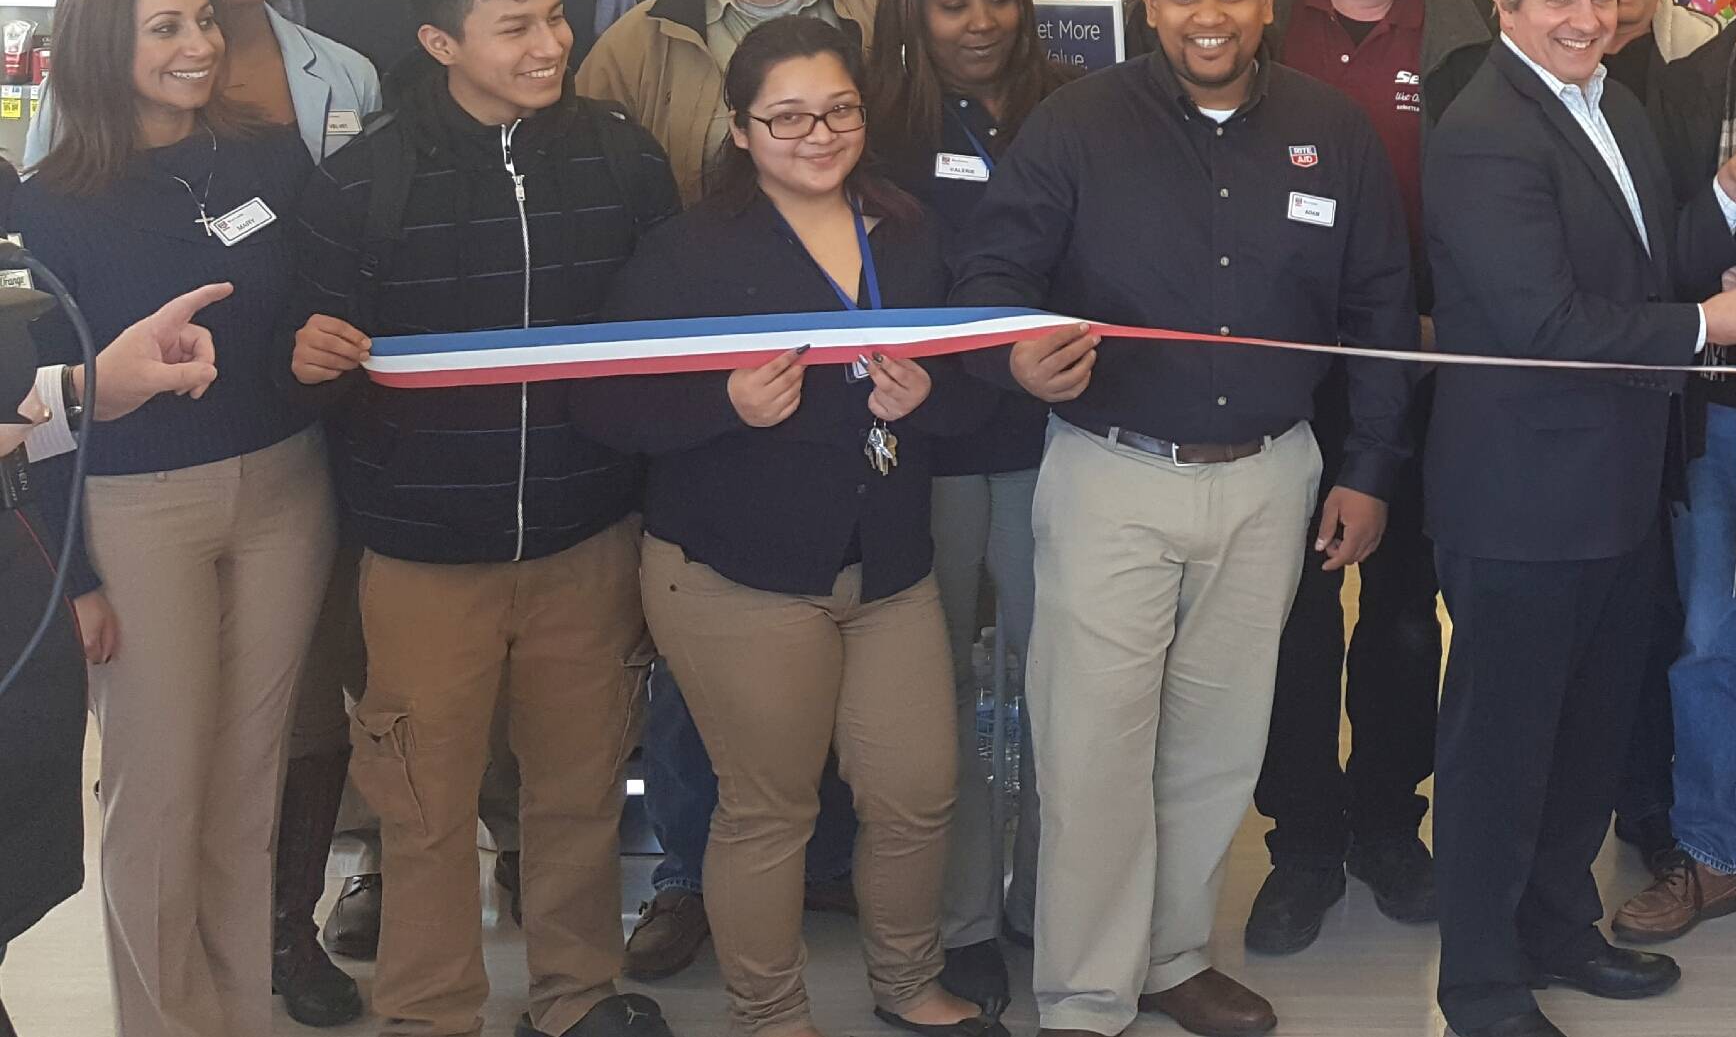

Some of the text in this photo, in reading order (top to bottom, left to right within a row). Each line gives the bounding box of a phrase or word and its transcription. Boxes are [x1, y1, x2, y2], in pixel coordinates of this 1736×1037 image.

[1037, 19, 1101, 41] et More
[1394, 70, 1420, 85] Se
[1297, 155, 1313, 164] AID
